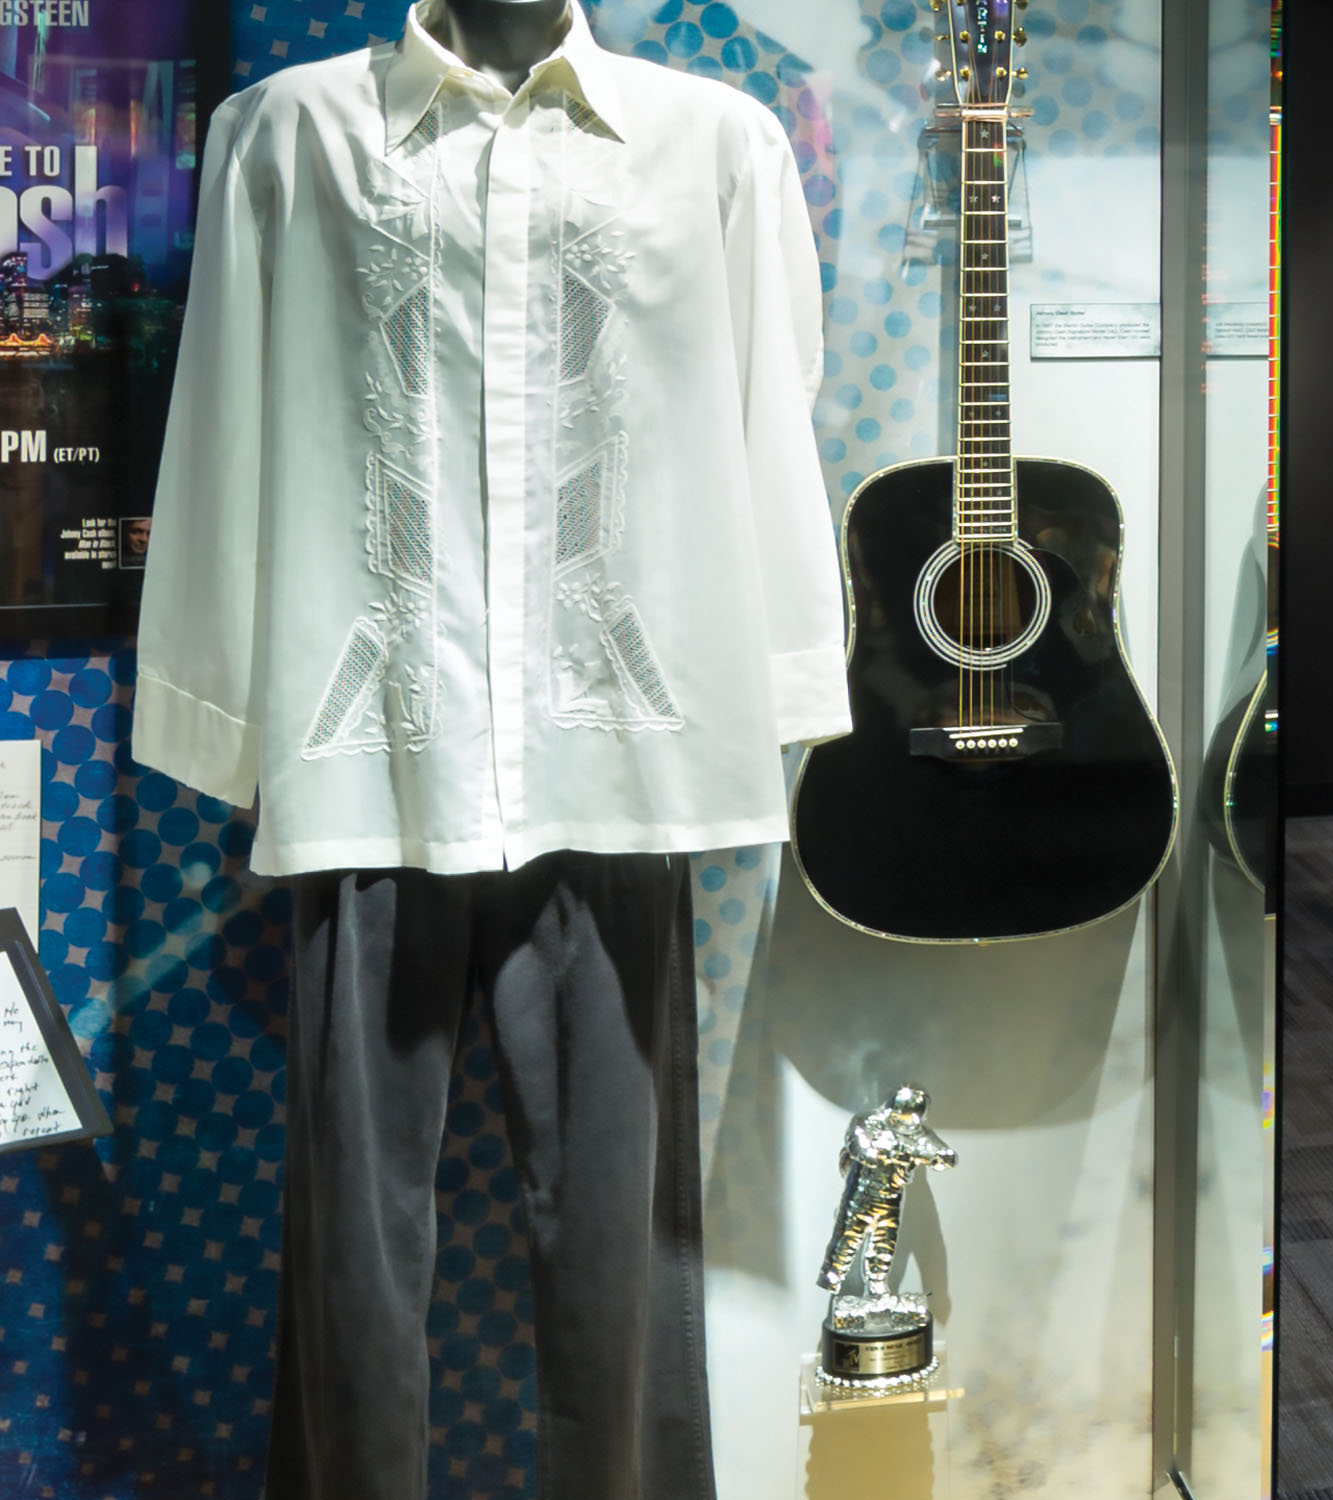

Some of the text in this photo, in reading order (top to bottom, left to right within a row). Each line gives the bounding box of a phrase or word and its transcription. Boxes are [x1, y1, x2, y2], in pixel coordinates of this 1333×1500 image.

[25, 145, 60, 177] TO
[0, 429, 100, 464] PM (ET/PT)
